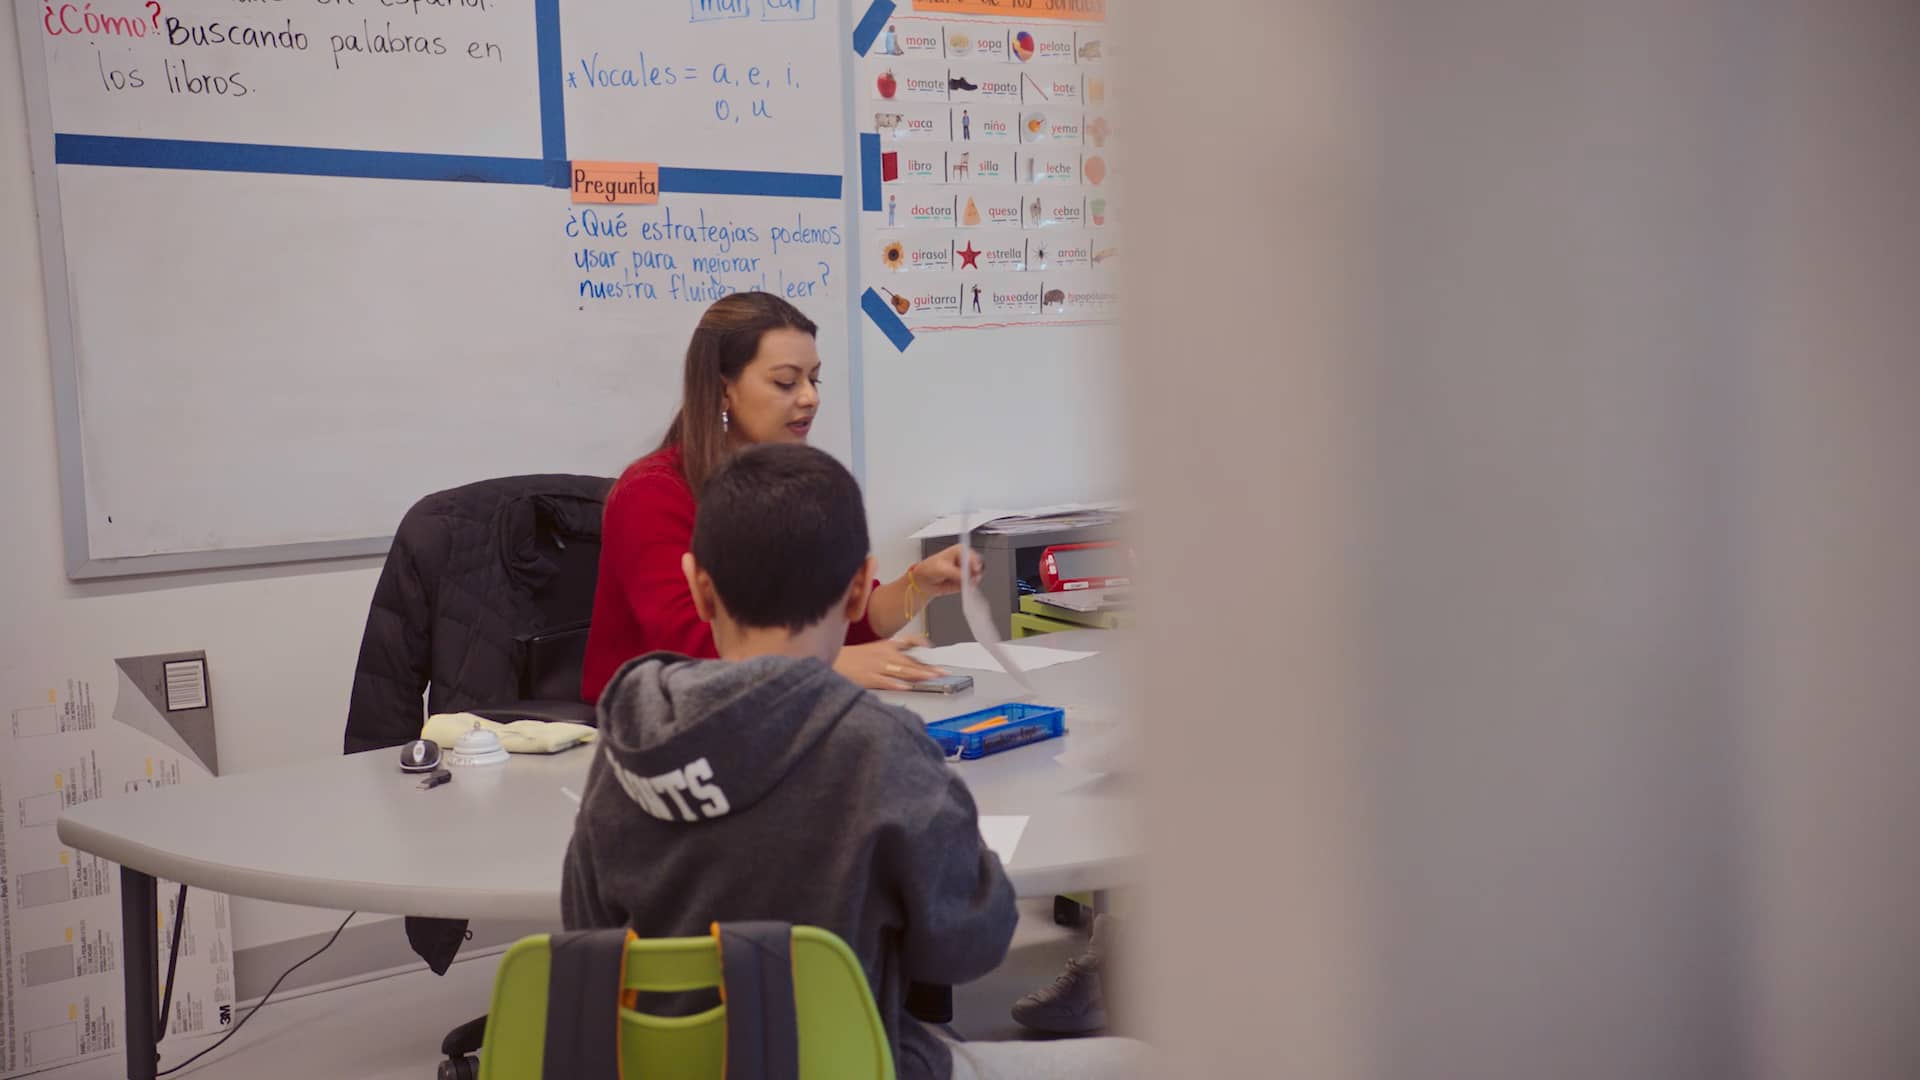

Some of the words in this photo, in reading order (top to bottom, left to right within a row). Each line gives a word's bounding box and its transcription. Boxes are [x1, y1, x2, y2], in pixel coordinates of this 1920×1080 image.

[44, 1, 161, 38] ¿Cómo?
[166, 17, 309, 53] Buscando
[330, 19, 447, 69] palabras
[467, 41, 502, 62] en
[905, 36, 936, 46] mono
[977, 39, 1002, 49] sopa
[1040, 40, 1071, 52] pelota
[98, 50, 144, 91] los
[165, 59, 256, 97] libros.
[581, 52, 677, 88] Vocales
[907, 78, 945, 90] tomate
[982, 82, 1017, 93] zapato
[1053, 82, 1076, 93] bate
[908, 119, 933, 129] vaca
[984, 119, 1006, 131] niño
[1051, 124, 1078, 134] yema
[908, 159, 932, 171] libro
[979, 161, 999, 171] silla
[1046, 160, 1072, 174] leche
[574, 169, 656, 202] Pregunta
[911, 204, 951, 215] doctora
[988, 207, 1017, 218] queso
[1053, 204, 1080, 215] cebra
[566, 207, 628, 238] ¿Qué
[642, 207, 759, 252] estrategias
[771, 213, 841, 254] podemos
[911, 249, 947, 261] girasol
[986, 249, 1022, 259] estrella
[1058, 248, 1086, 257] araña
[633, 250, 676, 277] para
[692, 257, 760, 280] mejorar
[580, 268, 656, 300] nuestra
[779, 262, 830, 298] leer?
[914, 295, 957, 306] guitarra
[993, 292, 1038, 303] boxeador
[219, 1004, 231, 1025] 3M
